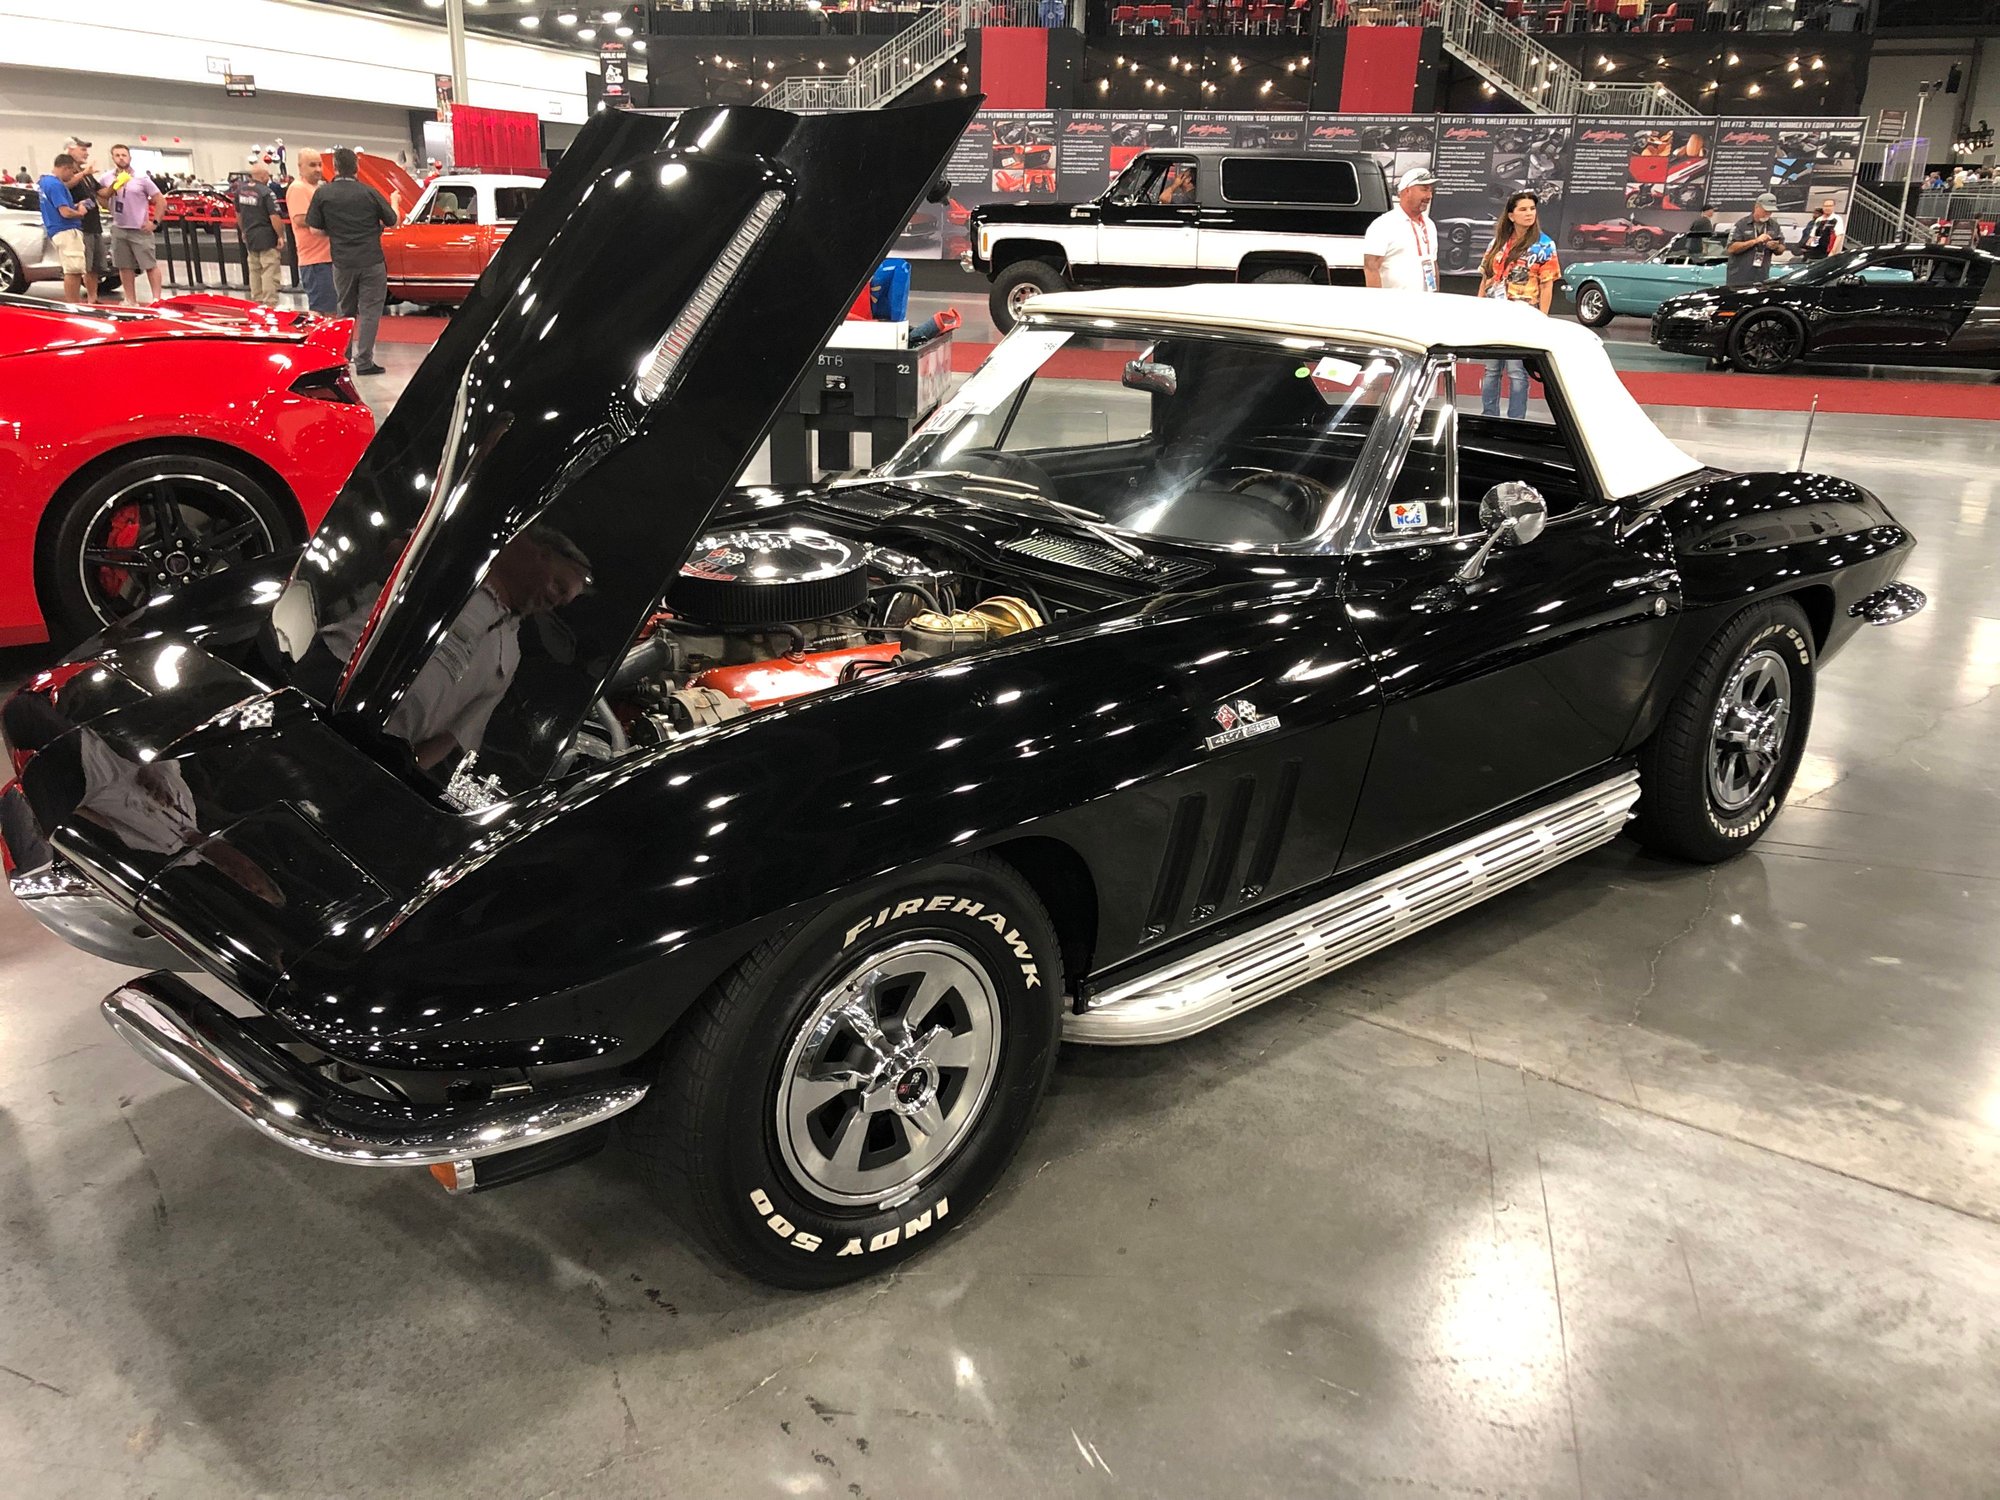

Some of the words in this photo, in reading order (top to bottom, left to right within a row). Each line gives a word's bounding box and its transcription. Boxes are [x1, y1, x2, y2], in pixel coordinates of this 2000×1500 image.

[1765, 121, 1778, 129] GMC
[896, 364, 911, 375] 22
[1786, 627, 1810, 666] 500
[842, 895, 1042, 990] FIREHAWK
[749, 1188, 823, 1252] 500
[836, 1196, 949, 1257] INDY
